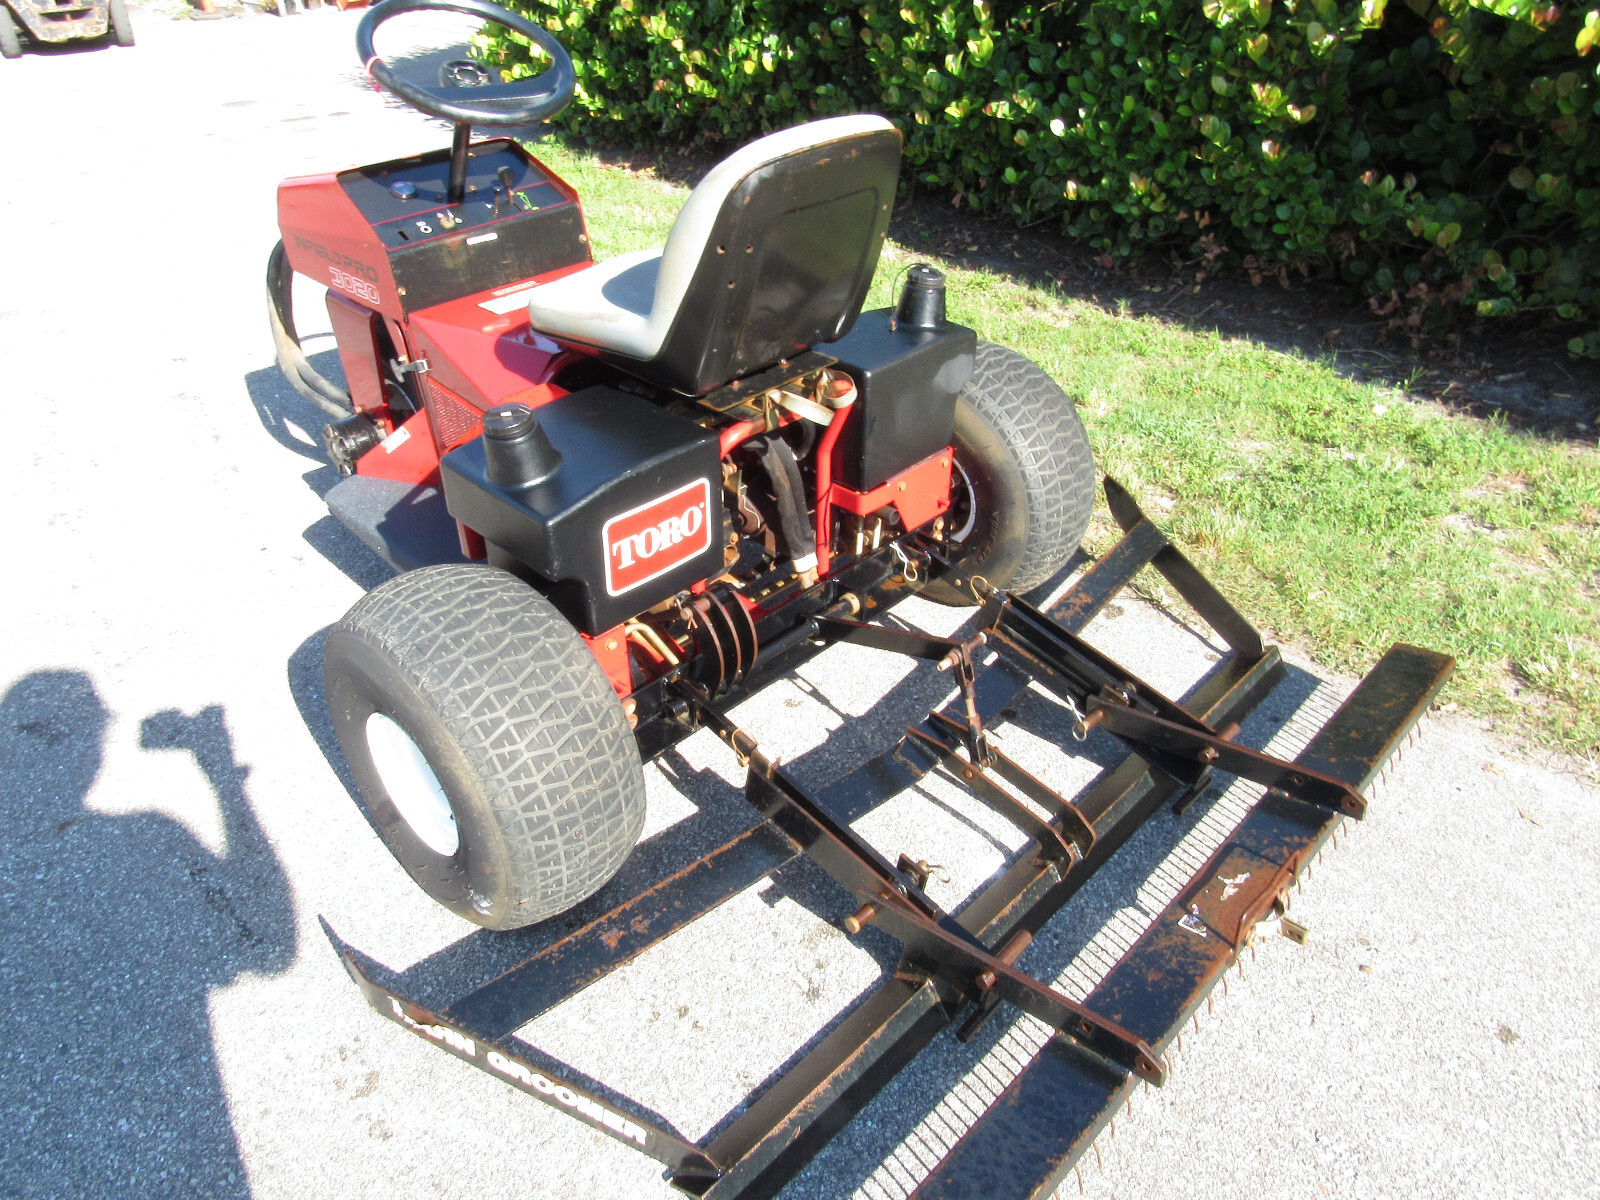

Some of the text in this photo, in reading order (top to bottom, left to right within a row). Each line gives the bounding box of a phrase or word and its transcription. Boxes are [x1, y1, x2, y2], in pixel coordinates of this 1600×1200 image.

[328, 266, 380, 305] 3020
[612, 504, 704, 570] TORO
[486, 1051, 648, 1146] GROOMER
